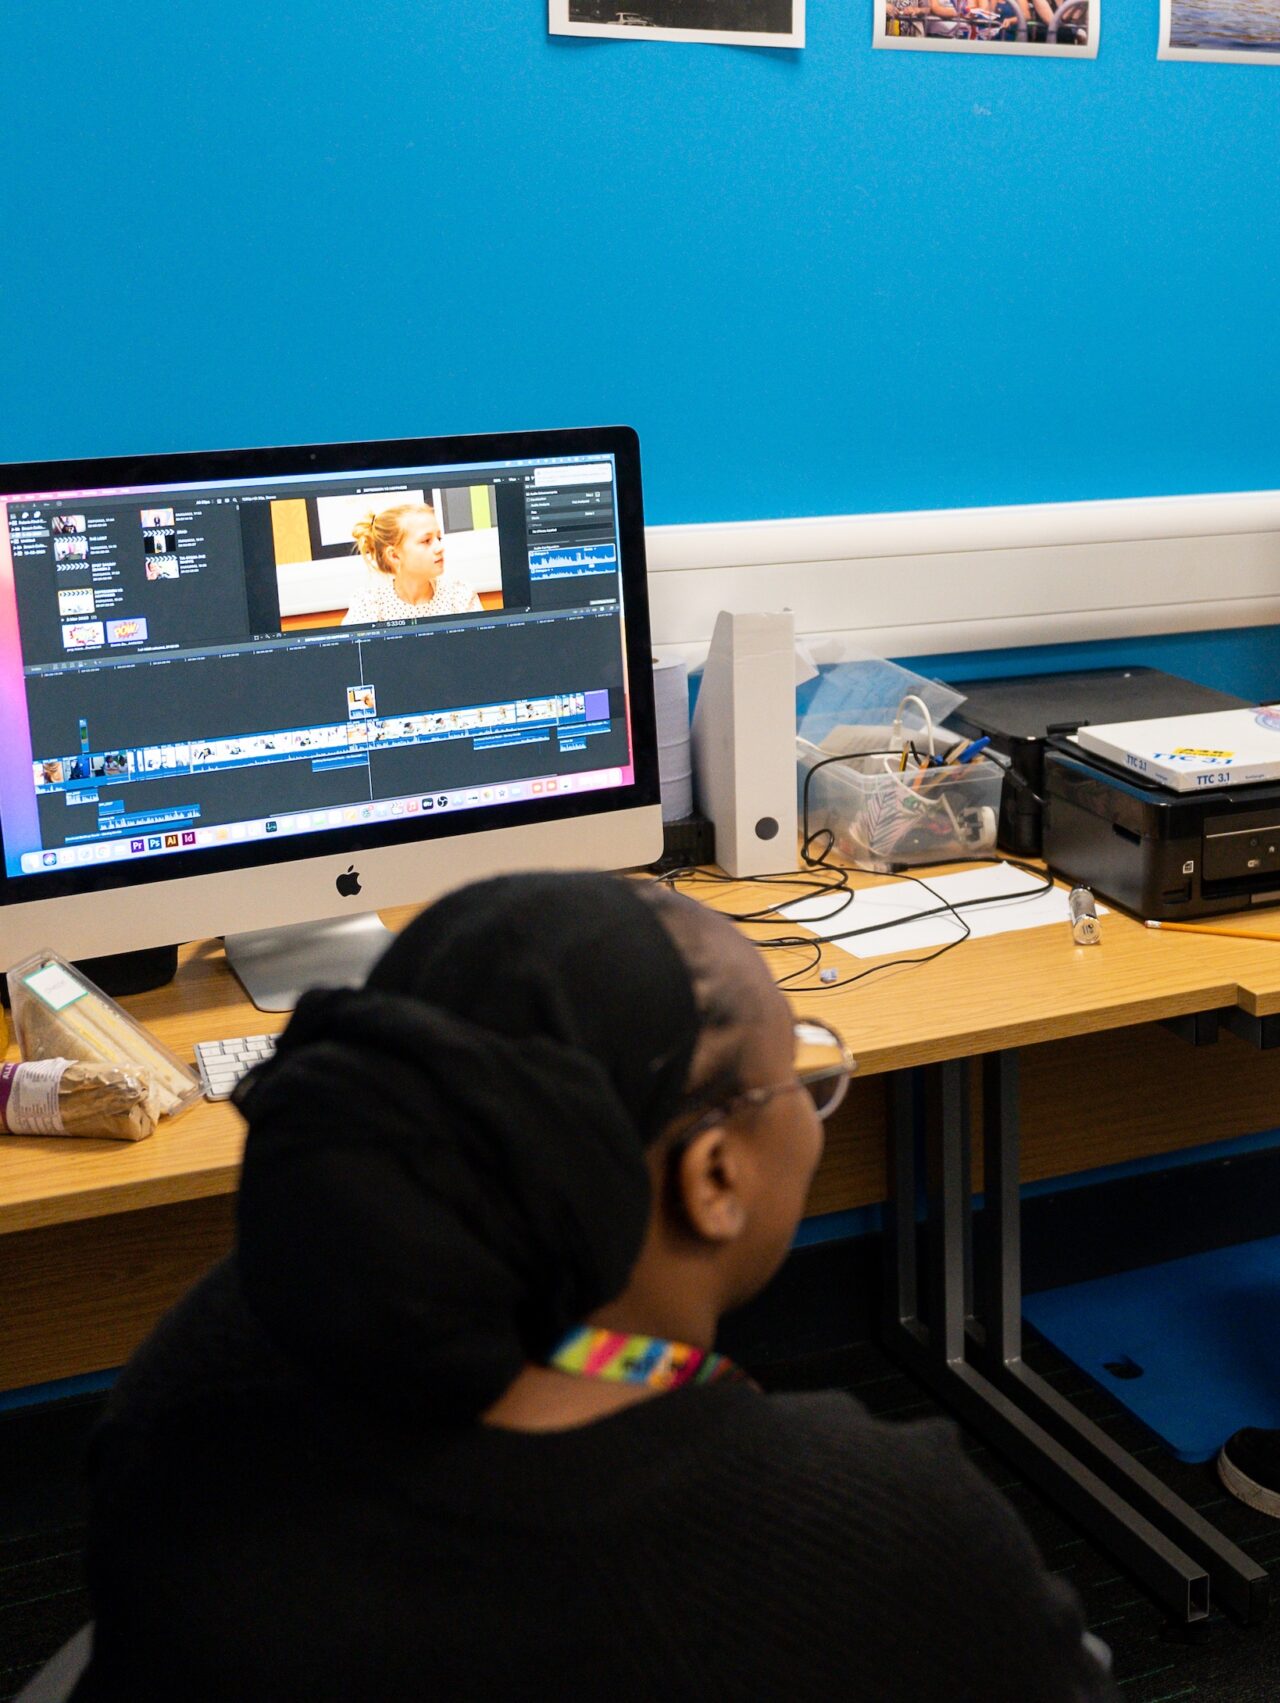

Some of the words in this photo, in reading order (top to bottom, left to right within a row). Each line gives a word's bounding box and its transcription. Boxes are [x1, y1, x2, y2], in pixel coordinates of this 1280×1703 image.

[1196, 774, 1215, 785] TTC
[1218, 773, 1230, 783] 3.1
[133, 841, 143, 850] Pr
[150, 839, 160, 848] Ps
[184, 833, 193, 842] Id
